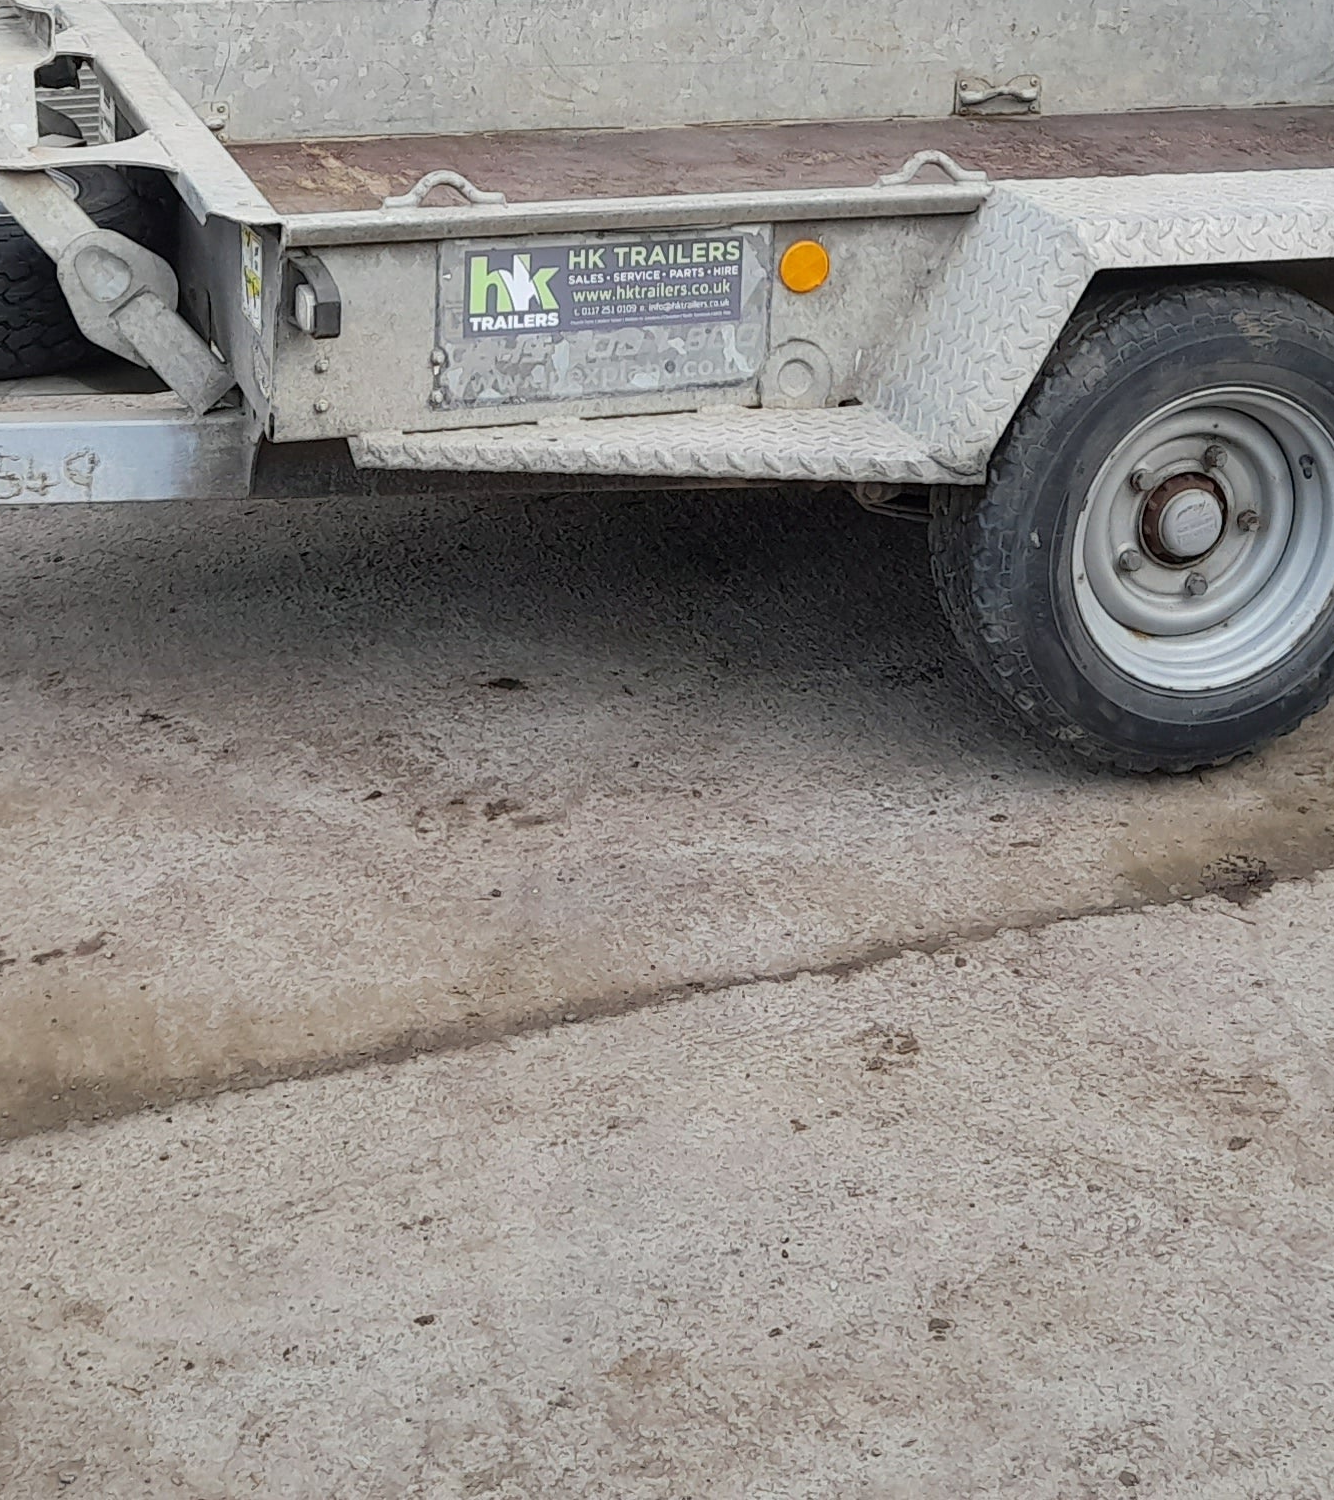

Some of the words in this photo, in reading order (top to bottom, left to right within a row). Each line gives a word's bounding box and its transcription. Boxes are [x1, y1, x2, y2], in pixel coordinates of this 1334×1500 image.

[568, 248, 606, 270] HK
[613, 240, 741, 268] TRAILERS
[568, 273, 604, 286] SALES
[613, 270, 661, 283] SERVICE
[669, 267, 705, 279] PARTS
[713, 265, 740, 277] HIRE
[573, 278, 731, 304] www.hktrailers.co.uk
[469, 312, 560, 332] TRAILERS
